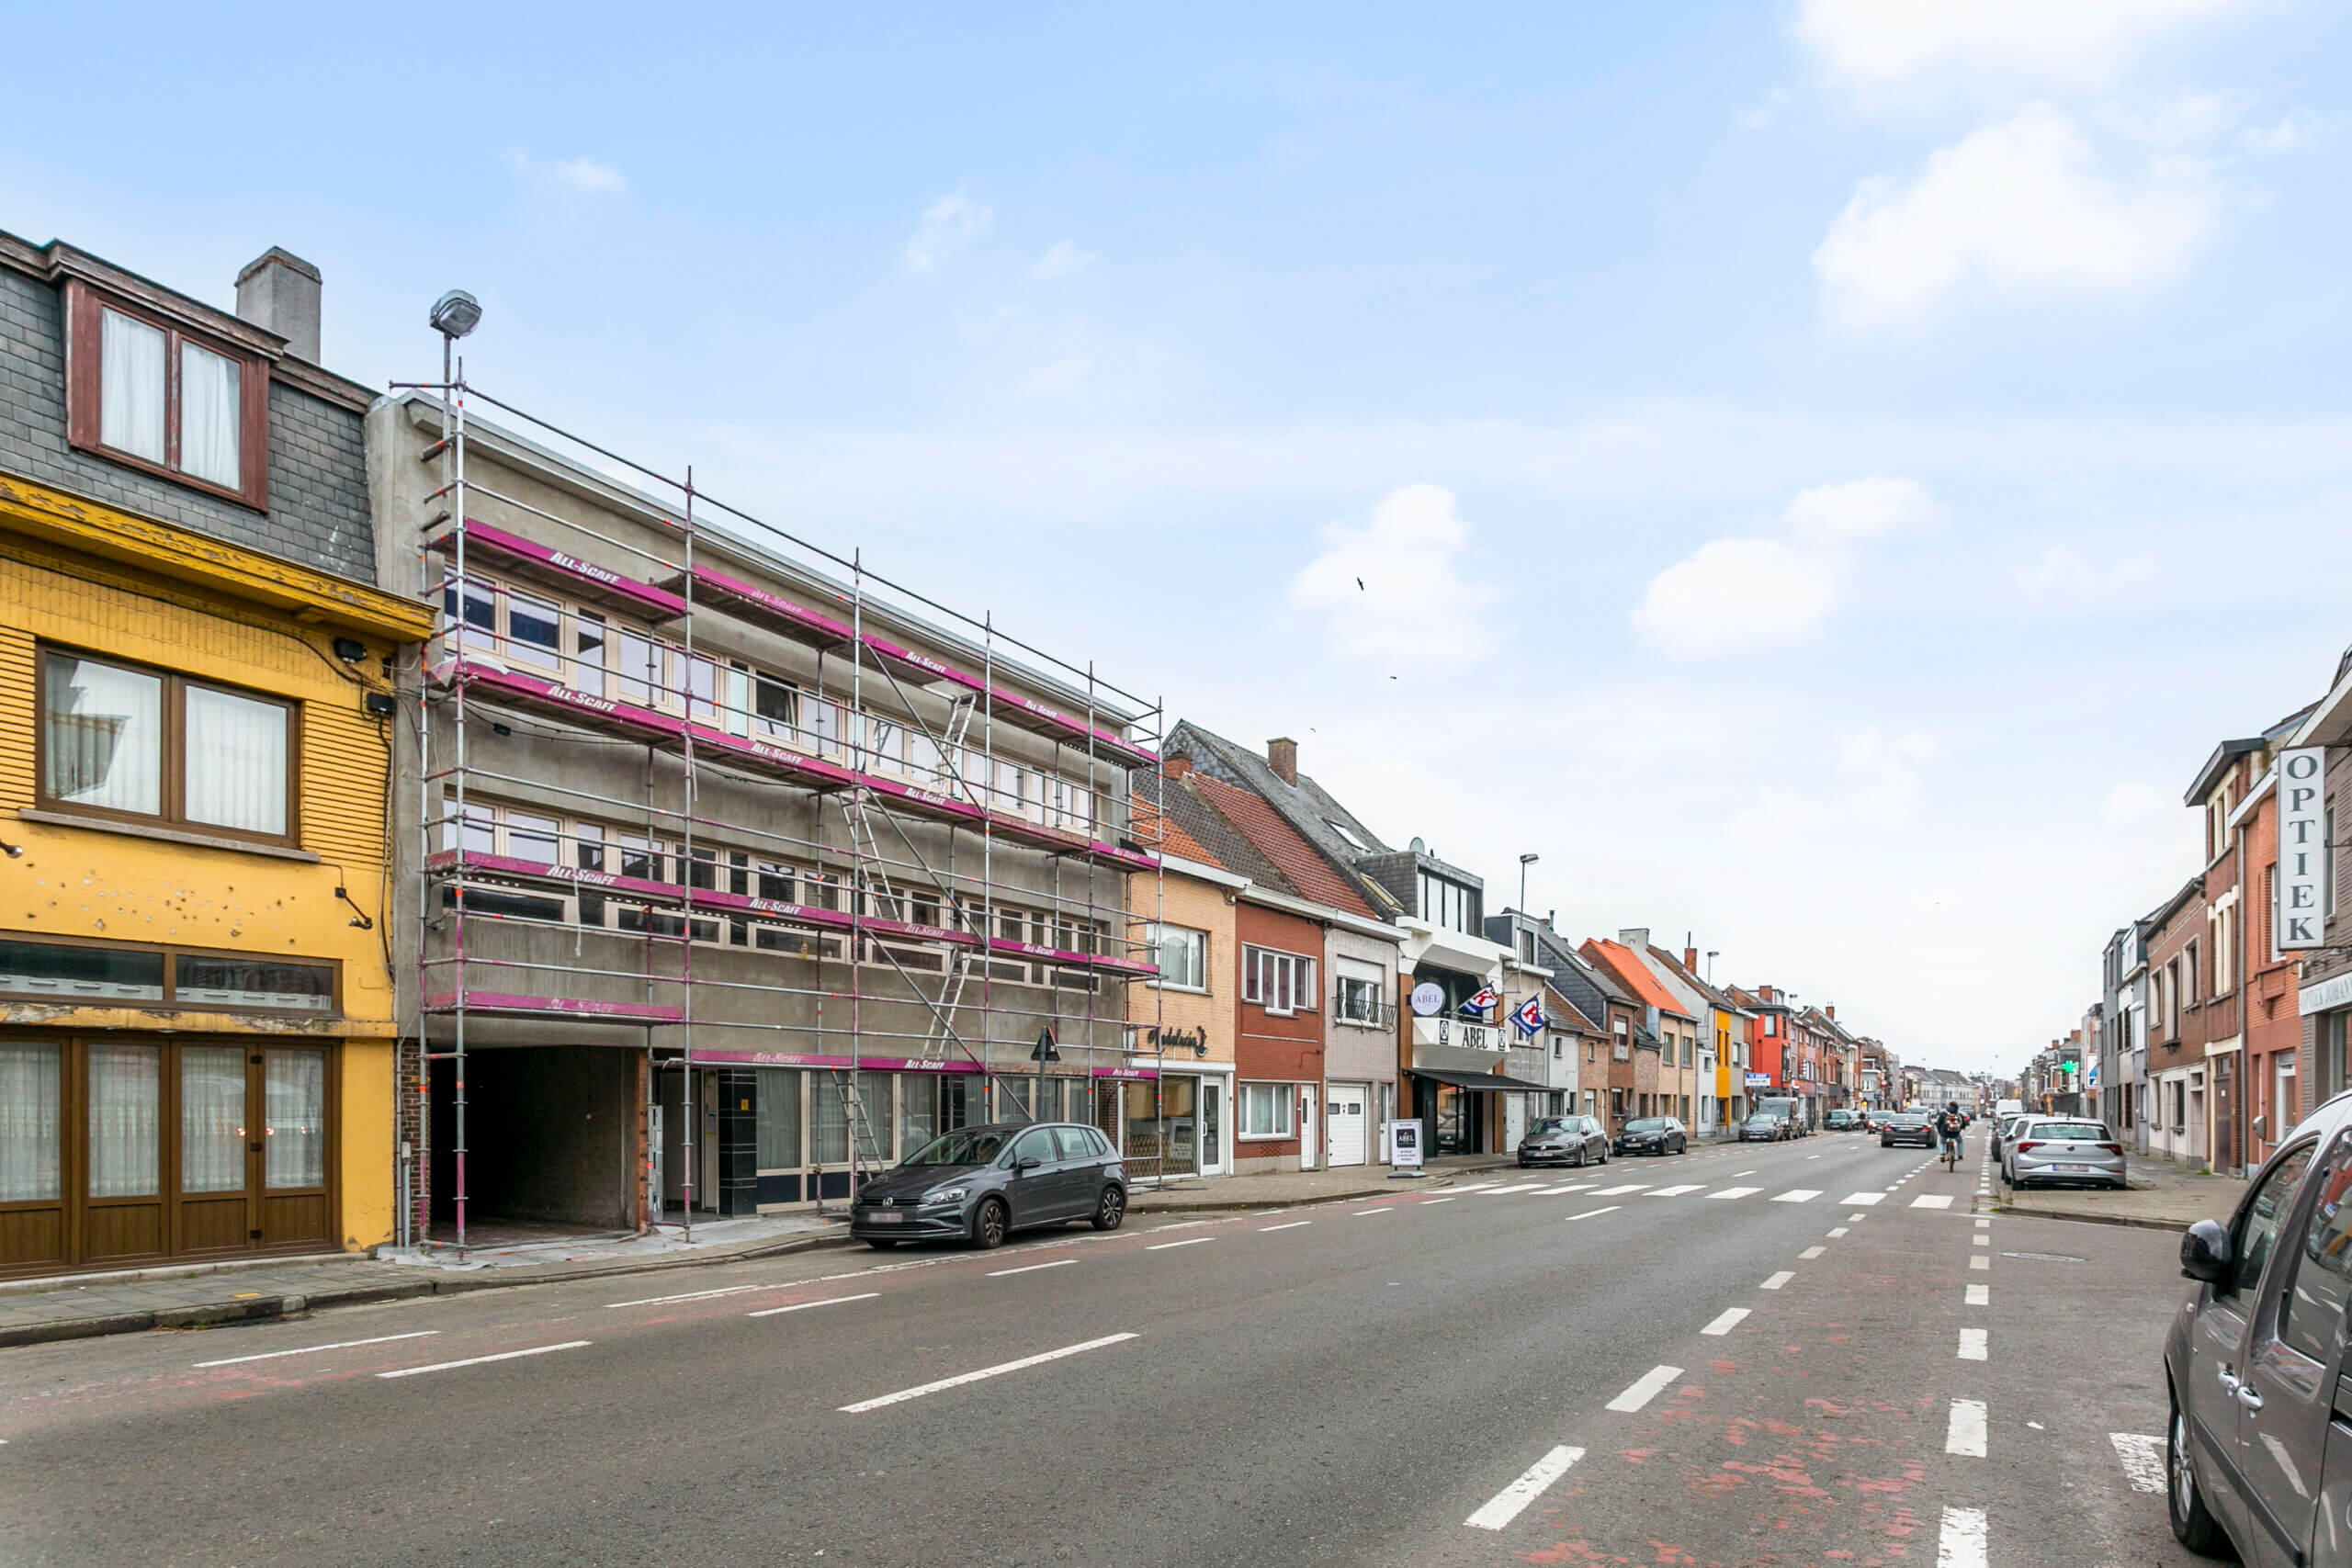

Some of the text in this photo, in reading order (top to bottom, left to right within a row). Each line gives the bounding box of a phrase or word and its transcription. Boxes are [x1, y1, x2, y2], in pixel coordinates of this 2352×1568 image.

[548, 550, 619, 585] ALL-SCAFF
[906, 651, 946, 673] ALL-SCAFF
[548, 684, 617, 714] ALL-SCAFF
[751, 743, 804, 765] ALL-SCAFF
[905, 787, 945, 807] ALL-SCAFF
[2287, 755, 2319, 942] OPTIEK
[546, 864, 617, 886] ALL-SCAFF
[749, 897, 801, 916] ALL-SCAFF
[1023, 943, 1056, 957] ALL-SCAFF
[1415, 994, 1441, 1004] ABEL
[1462, 1025, 1488, 1050] ABEL
[904, 1058, 944, 1071] ALL-SCAFF
